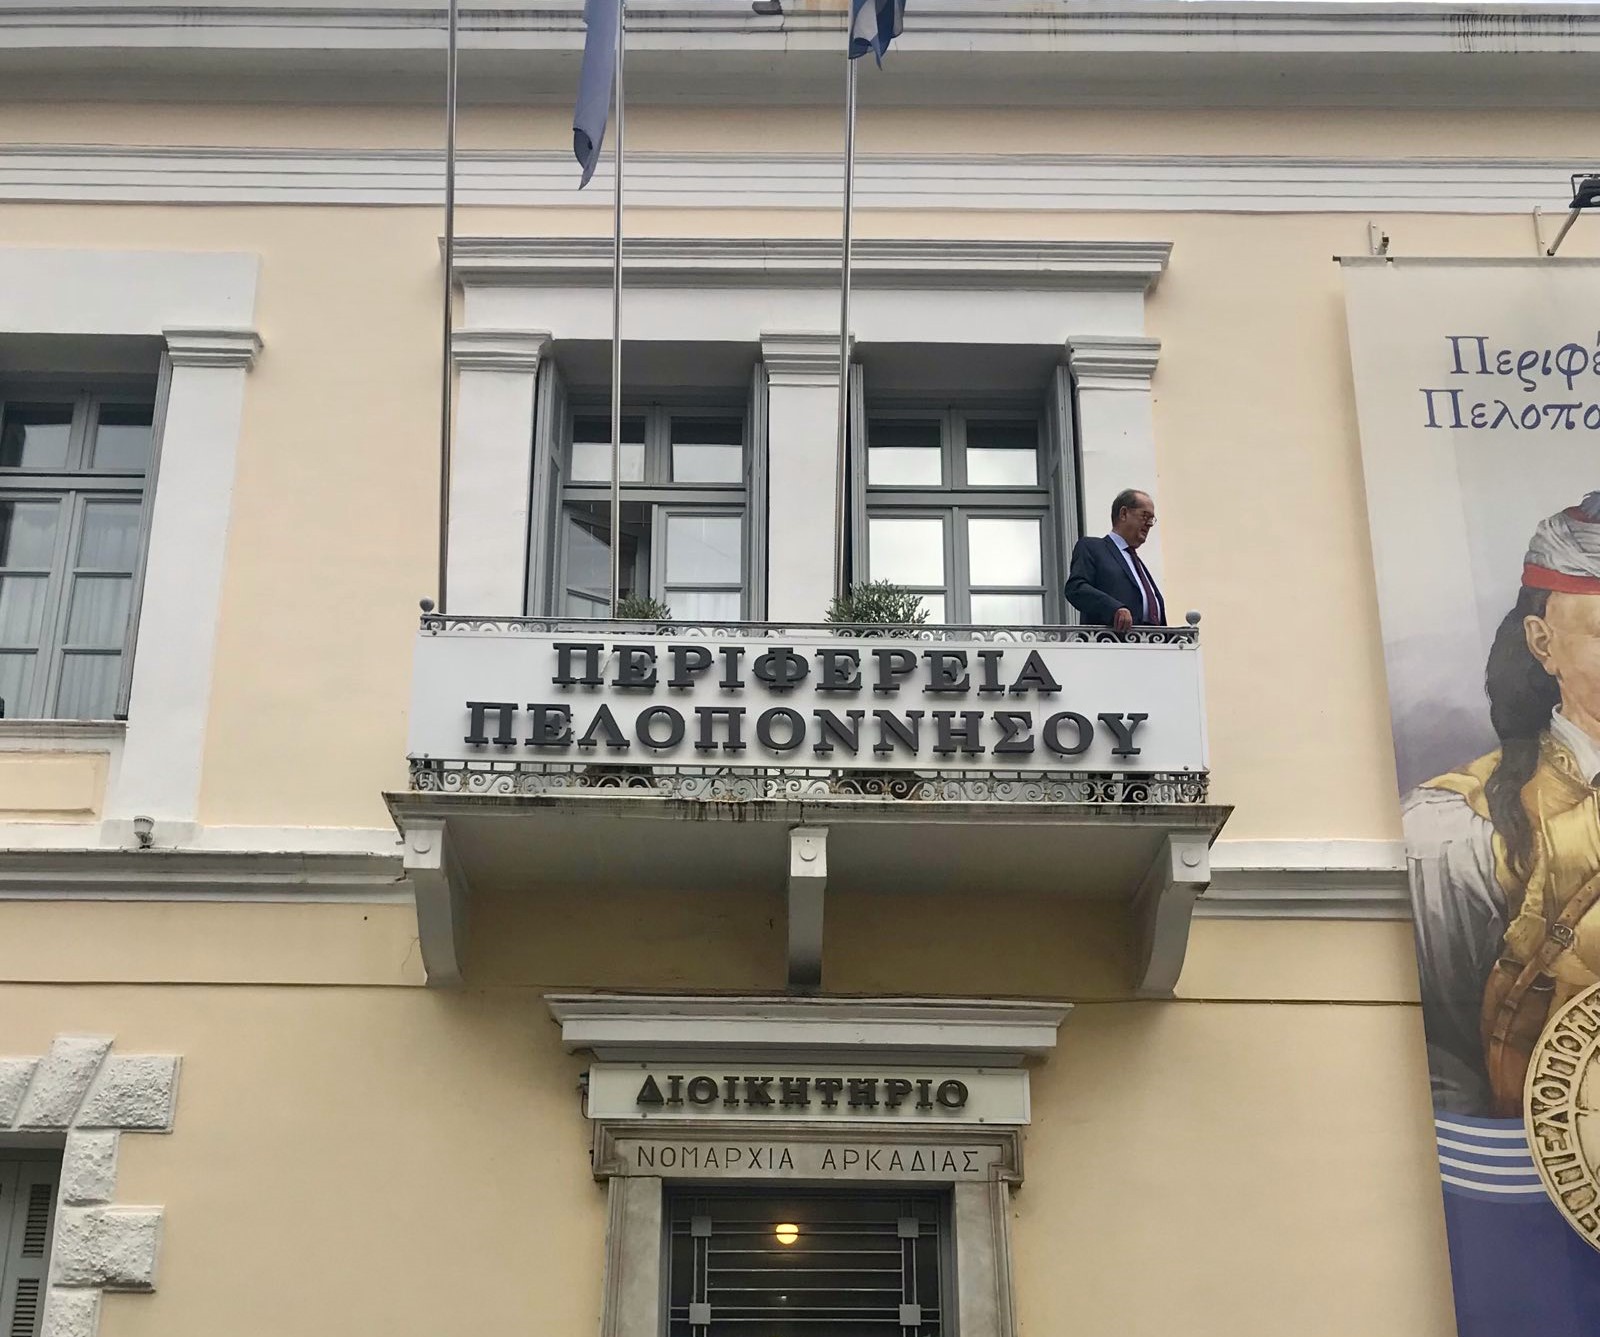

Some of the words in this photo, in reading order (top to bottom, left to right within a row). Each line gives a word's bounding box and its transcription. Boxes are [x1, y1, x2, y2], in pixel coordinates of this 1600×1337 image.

[1419, 388, 1600, 430] Πελοπο
[552, 643, 1062, 693] ΠΕΡΙΦΕΡΕΙΑ
[465, 701, 1148, 755] ΠΕΛΟΠΟΝΝΗΣΟΥ
[636, 1074, 969, 1108] ΔΙΟΙΚΗΤΗΡΙΟ
[636, 1144, 795, 1170] ΝΟΜΑΡΧΙΑ
[821, 1148, 980, 1172] ΑΡΚΑΔΙΑΣ
